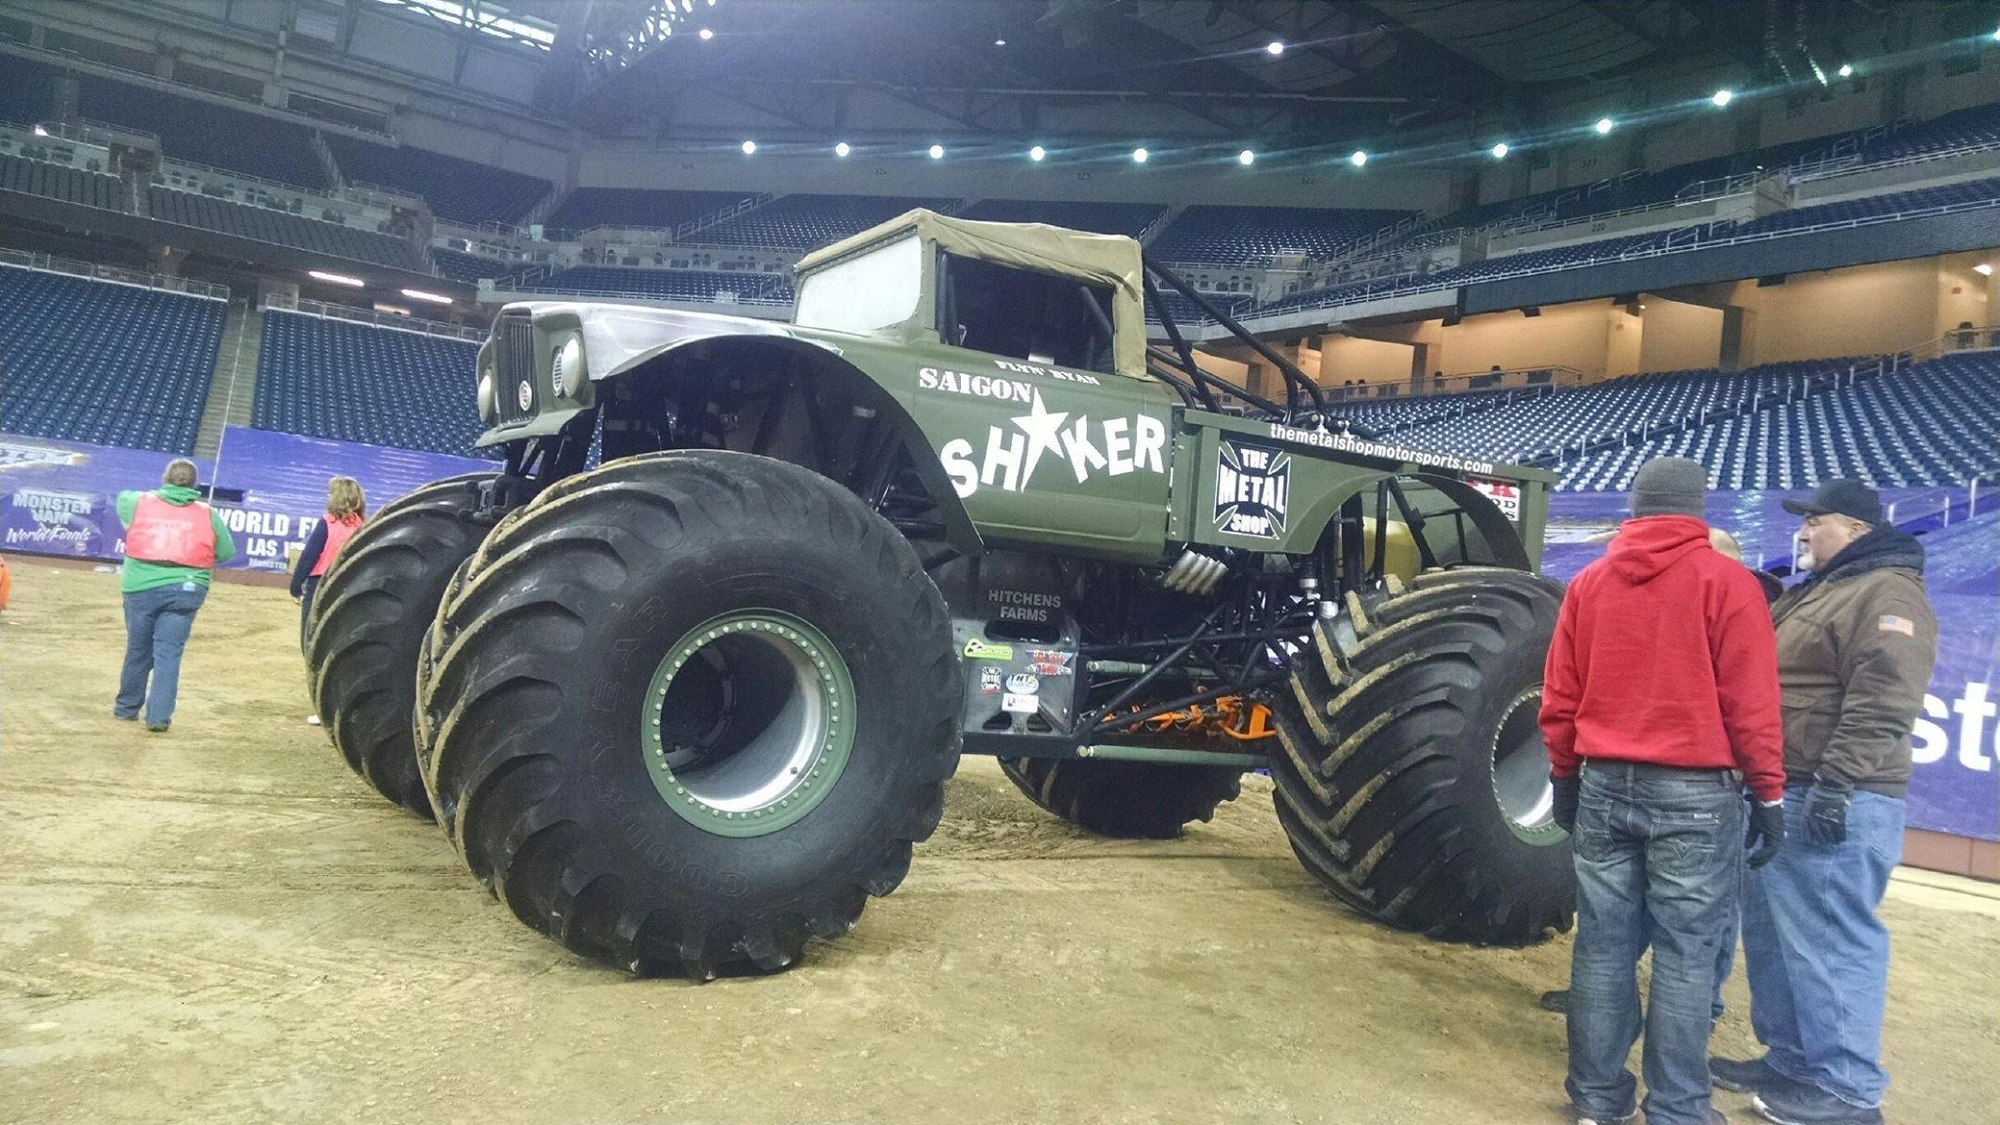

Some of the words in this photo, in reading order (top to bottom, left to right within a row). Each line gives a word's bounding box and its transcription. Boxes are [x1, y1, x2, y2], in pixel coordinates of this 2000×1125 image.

[919, 367, 1032, 403] SAIGON
[1048, 369, 1101, 386] RYAN
[1240, 448, 1270, 470] THE
[1269, 424, 1494, 475] themetalshopmotorsports.com
[1218, 463, 1285, 515] METAL
[12, 491, 92, 515] MONSTER
[31, 508, 70, 525] JAM
[212, 508, 290, 537] WORLD
[1230, 513, 1270, 535] SHOP
[245, 536, 279, 558] LAS
[988, 588, 1062, 609] HITCHENS
[1000, 604, 1048, 622] FARMS
[1911, 682, 2000, 772] st
